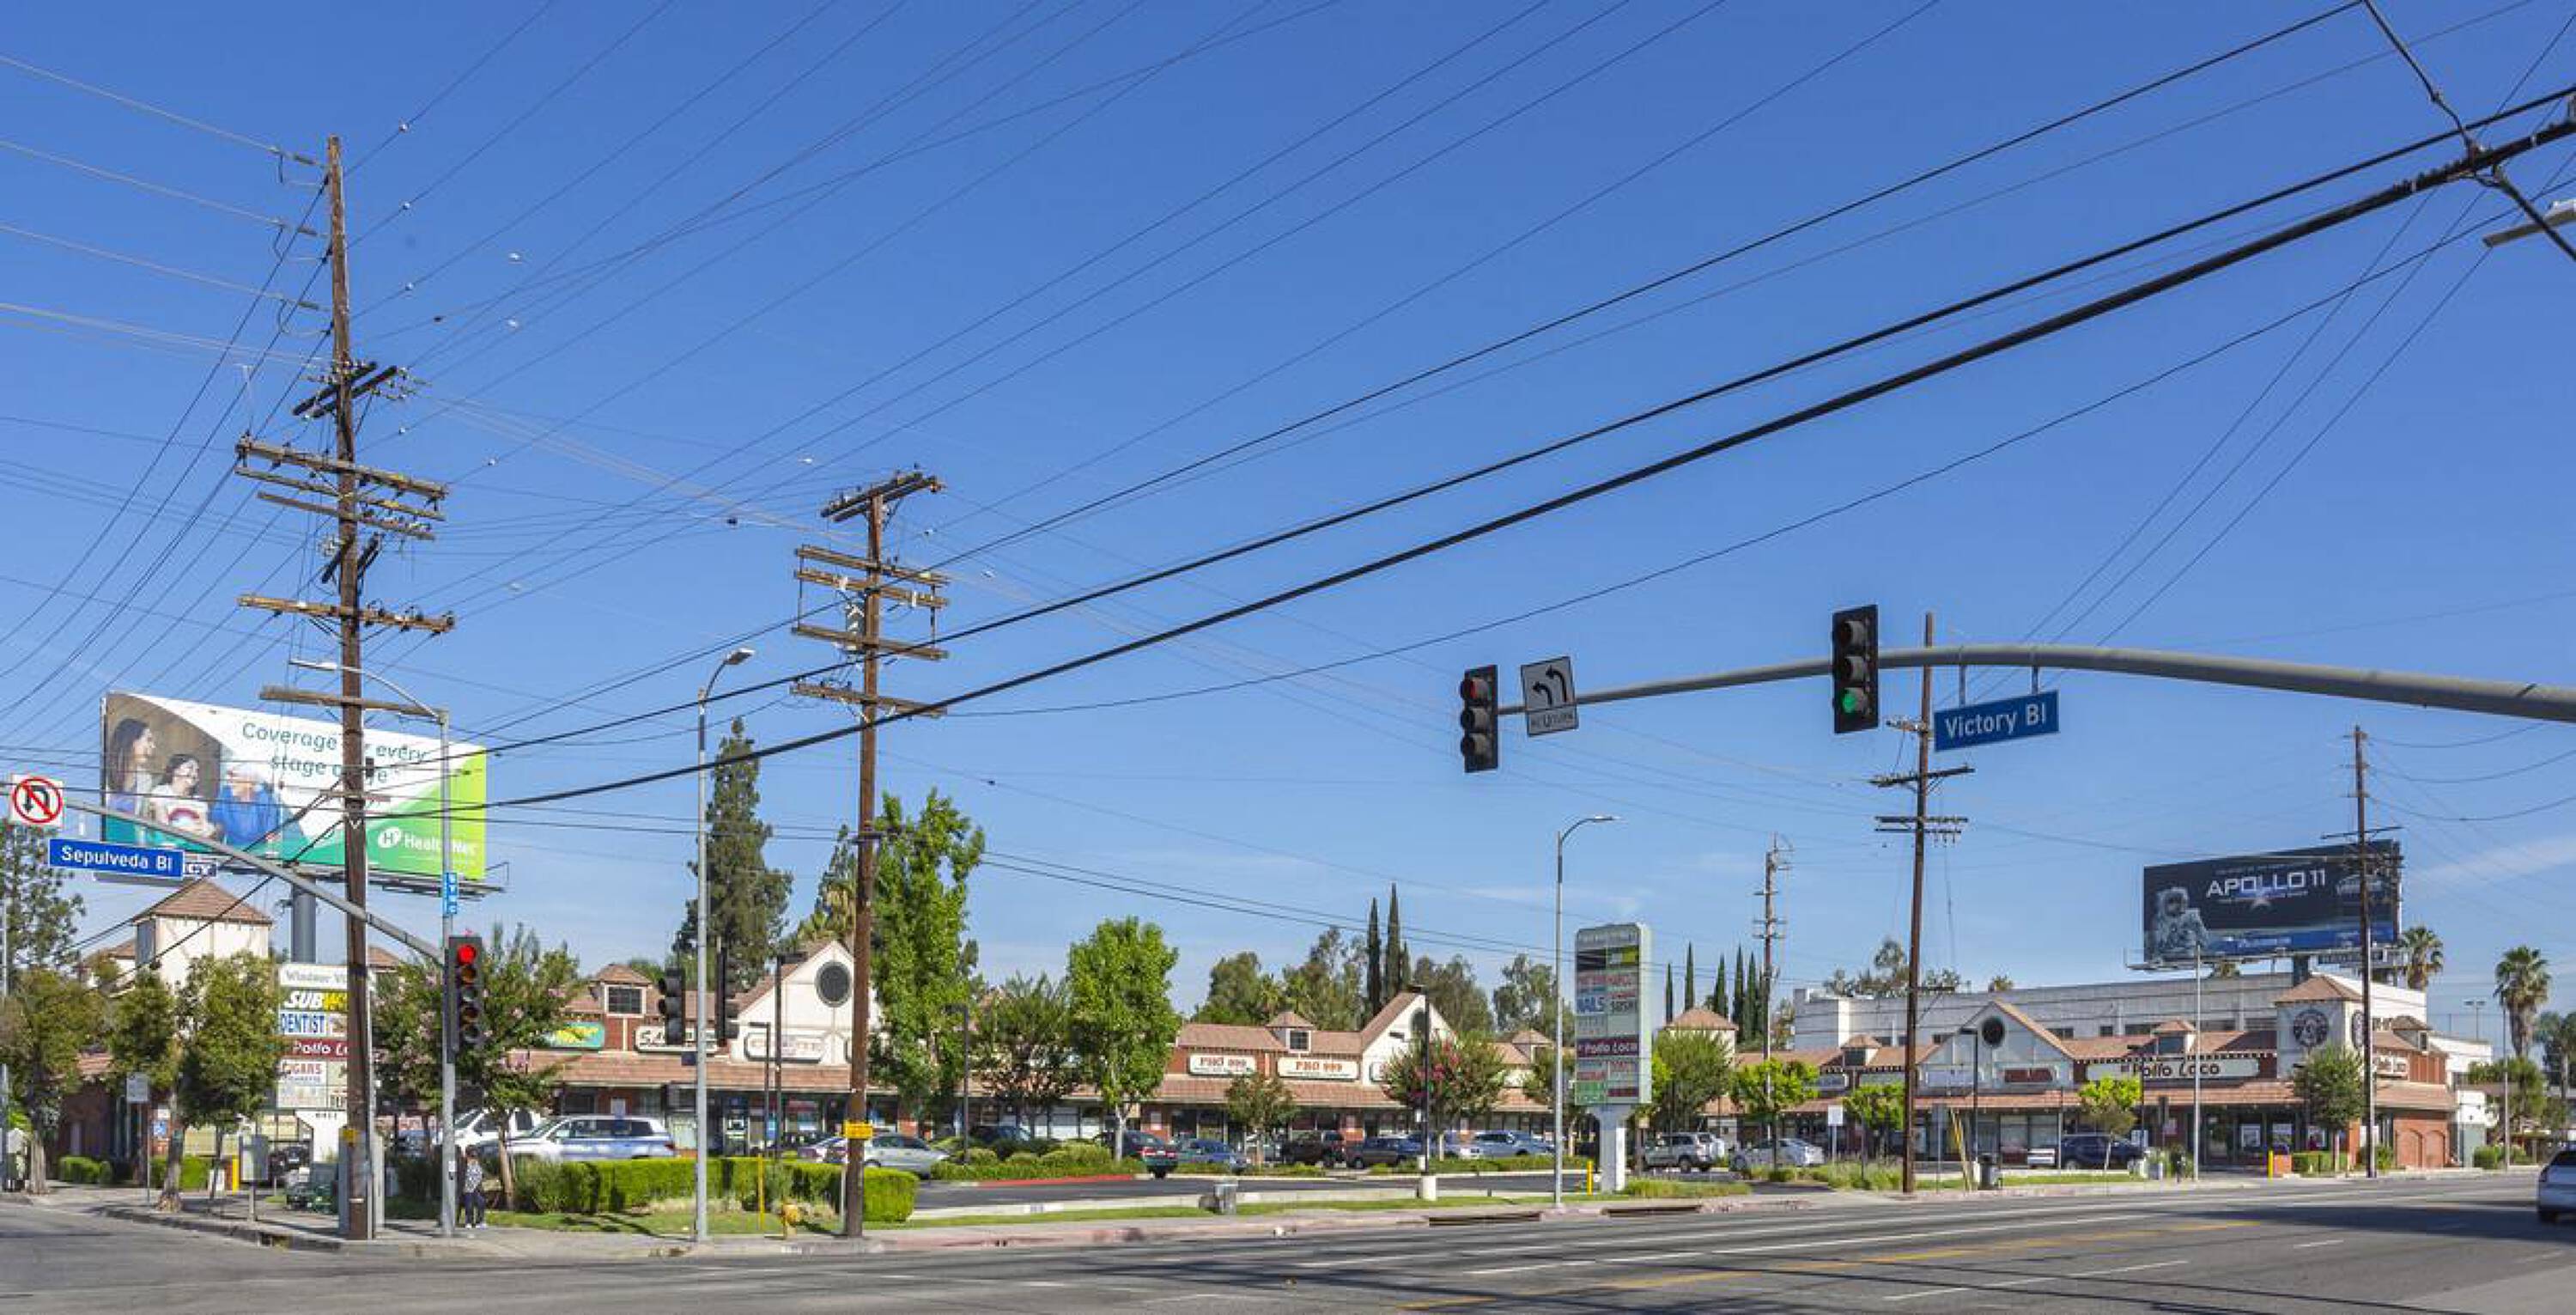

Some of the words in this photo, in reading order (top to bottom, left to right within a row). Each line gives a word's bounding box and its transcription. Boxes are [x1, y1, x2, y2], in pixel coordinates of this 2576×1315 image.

[1944, 710, 2018, 740] Victory
[2026, 703, 2046, 726] Bl
[242, 722, 337, 751] Coverage
[270, 755, 327, 777] stage
[61, 845, 149, 870] Sepulveda
[157, 855, 173, 872] Bl
[2206, 871, 2306, 898] APOLLO
[2310, 868, 2326, 887] 11
[279, 1013, 325, 1033] DENTIST
[2179, 1061, 2221, 1077] Loco
